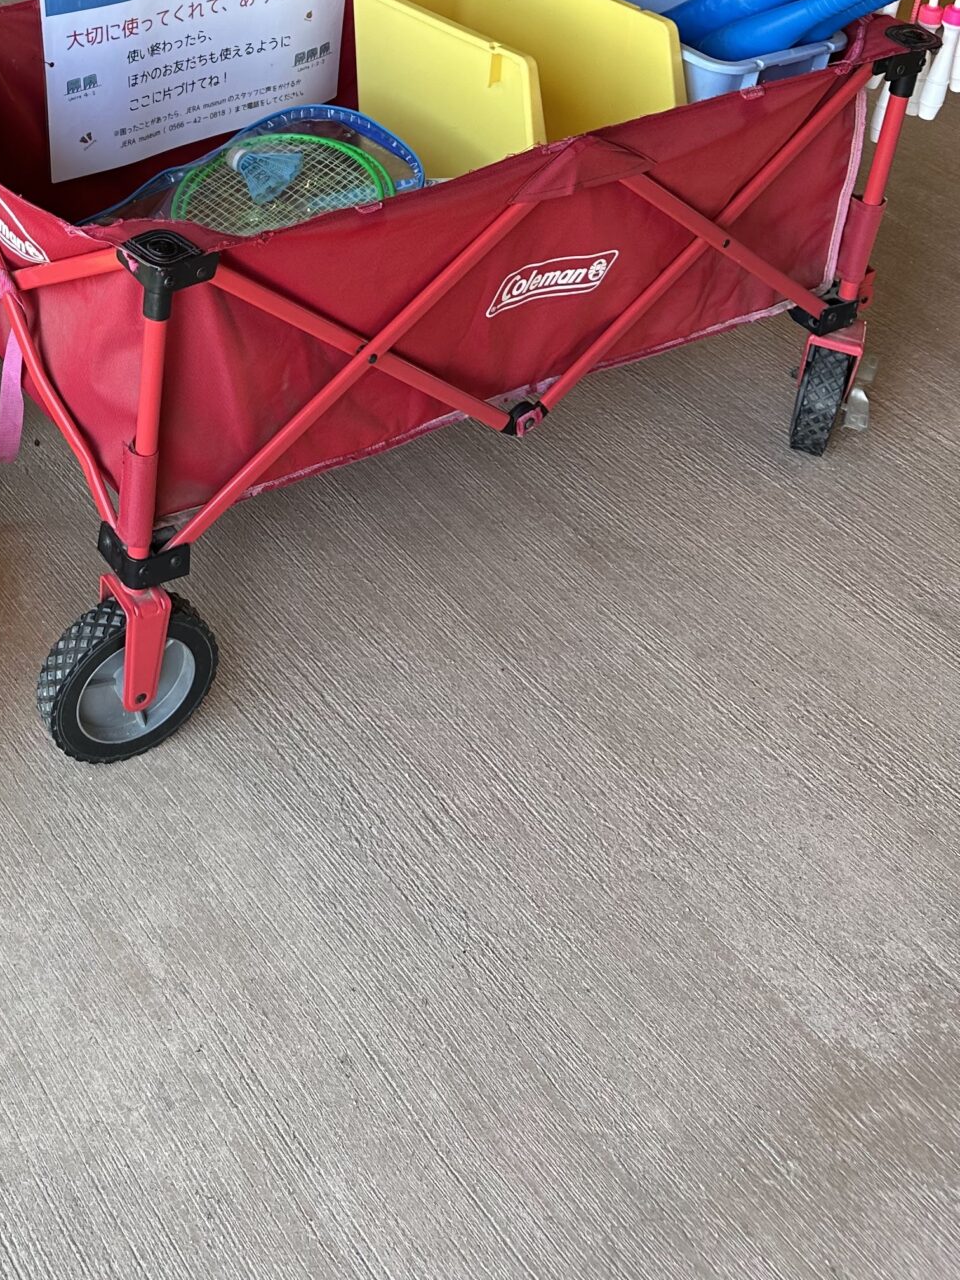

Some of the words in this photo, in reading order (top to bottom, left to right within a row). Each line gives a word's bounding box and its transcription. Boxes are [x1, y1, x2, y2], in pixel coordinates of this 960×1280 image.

[126, 30, 212, 65] 使い終わったら、
[127, 35, 292, 89] ほかのお友だちも使えるように
[501, 267, 589, 303] Coleman
